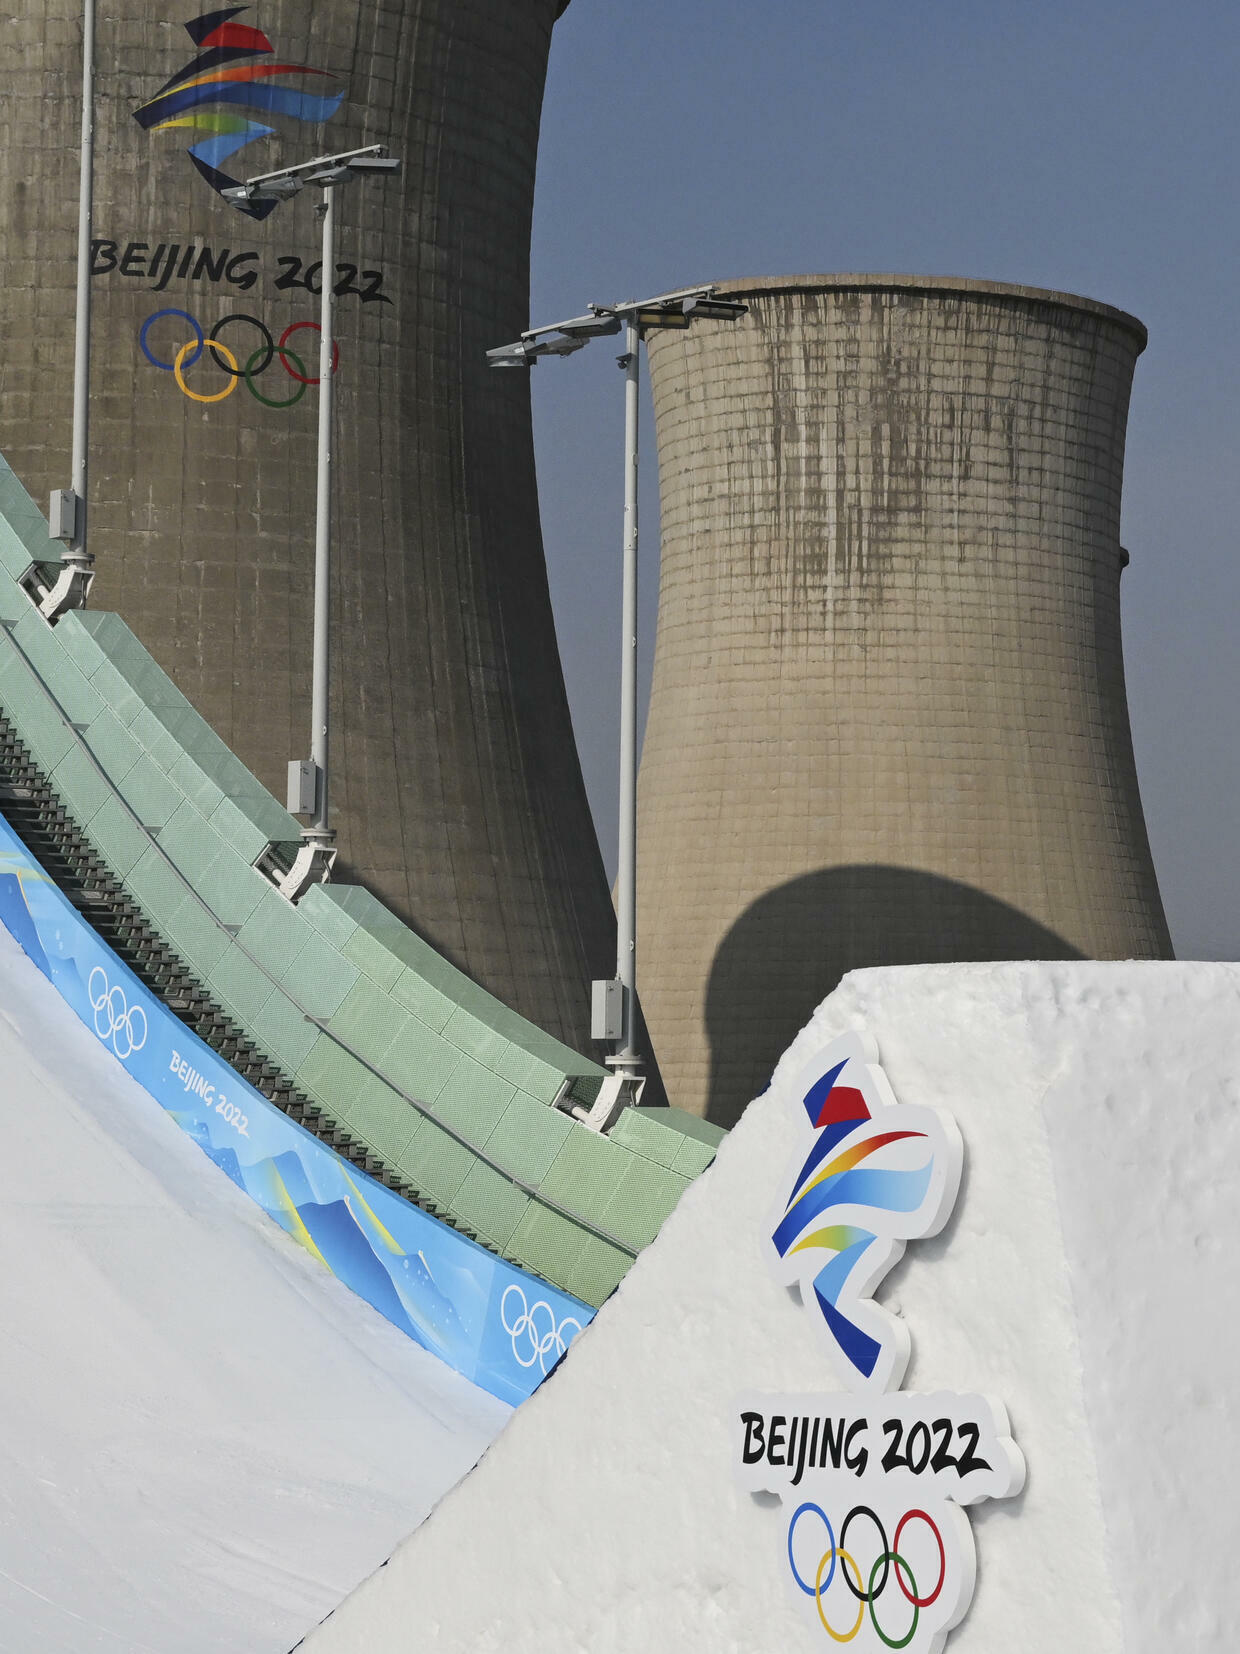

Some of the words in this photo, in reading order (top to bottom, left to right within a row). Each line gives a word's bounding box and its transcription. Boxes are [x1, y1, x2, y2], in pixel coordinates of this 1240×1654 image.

[90, 239, 260, 291] BEIJING
[274, 255, 394, 305] 2022
[169, 1050, 215, 1107] BEIJING
[215, 1094, 250, 1139] 2022
[740, 1411, 869, 1486] BEIJING
[881, 1417, 995, 1479] 2022
